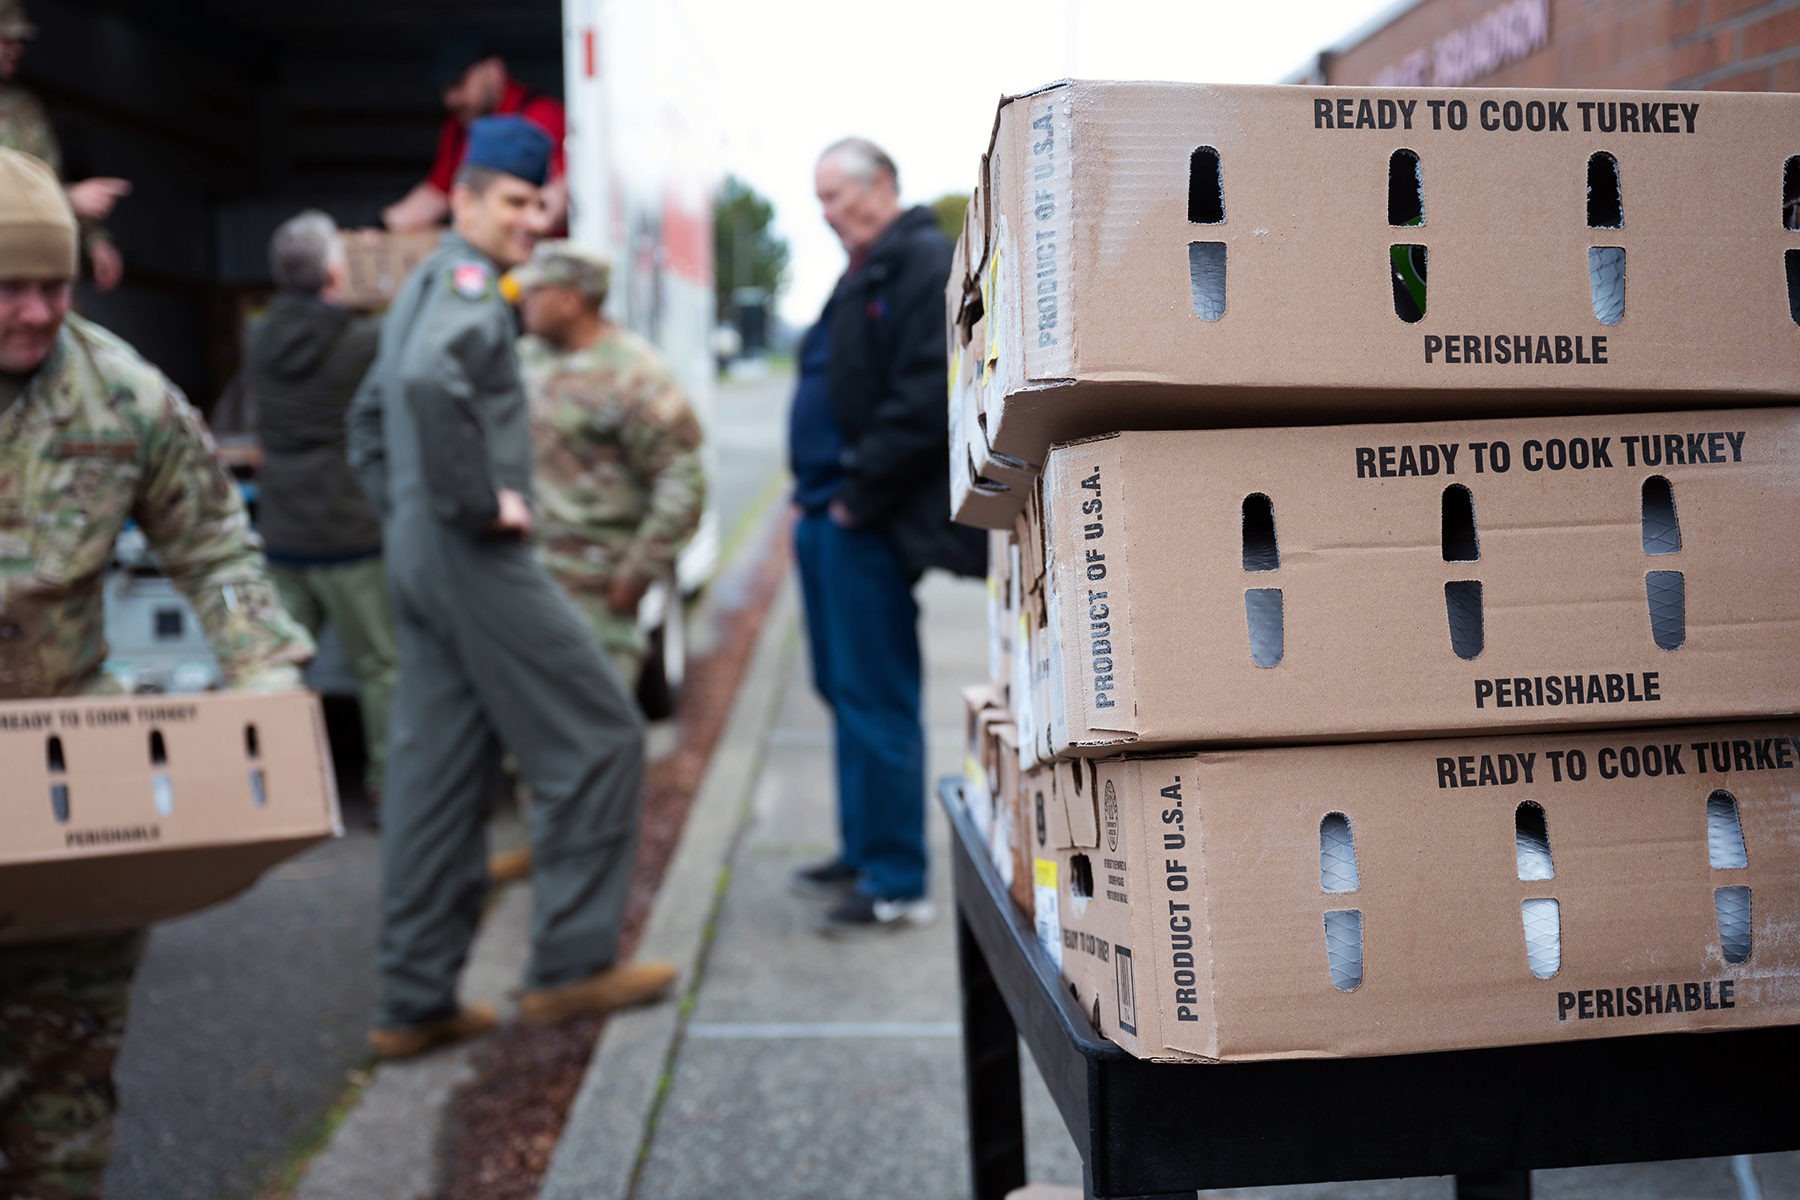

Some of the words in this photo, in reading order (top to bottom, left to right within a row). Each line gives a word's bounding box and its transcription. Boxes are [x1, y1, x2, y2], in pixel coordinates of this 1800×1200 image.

[1313, 98, 1417, 129] READY
[1427, 99, 1467, 131] TO
[1480, 99, 1569, 132] COOK
[1576, 102, 1699, 133] TURKEY
[1032, 105, 1055, 181] U.S.A.
[1035, 188, 1056, 222] OF
[1036, 230, 1058, 349] PRODUCT
[1425, 335, 1608, 364] PERISHABLE
[1356, 443, 1459, 478] READY
[1469, 441, 1510, 473] TO
[1523, 437, 1613, 471] COOK
[1620, 431, 1746, 467] TURKEY
[1081, 466, 1104, 540] U.S.A.
[1086, 549, 1107, 580] OF
[1088, 590, 1115, 708] PRODUCT
[1475, 672, 1661, 708] PERISHABLE
[60, 711, 80, 727] TO
[1436, 752, 1537, 788] READY
[1546, 750, 1588, 782] TO
[1598, 744, 1686, 779] COOK
[1161, 776, 1185, 849] U.S.A.
[1166, 860, 1188, 891] OF
[1169, 900, 1198, 1021] PRODUCT
[1557, 979, 1736, 1021] PERISHABLE
